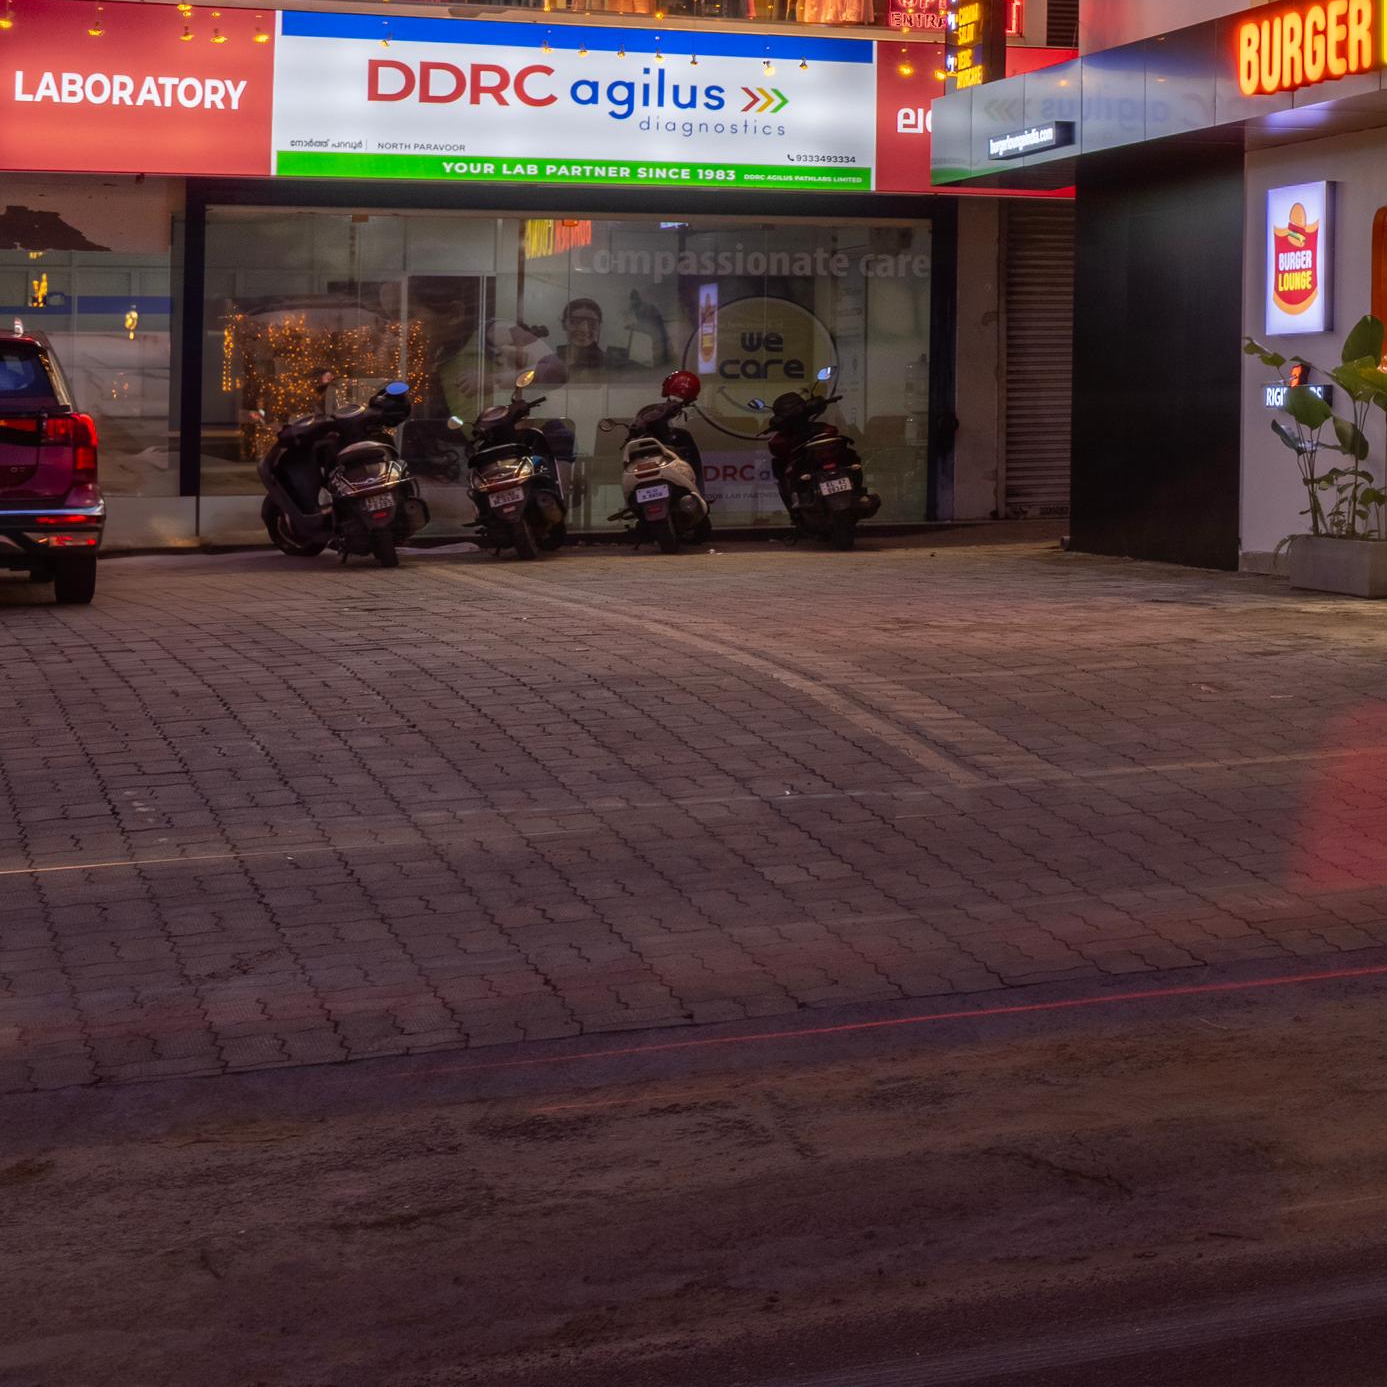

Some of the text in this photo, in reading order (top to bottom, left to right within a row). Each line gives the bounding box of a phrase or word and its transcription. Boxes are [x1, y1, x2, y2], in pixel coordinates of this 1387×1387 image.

[890, 11, 947, 29] ENTRA
[14, 70, 248, 111] LABORATORY
[367, 58, 726, 121] DDRC agilus
[639, 114, 787, 138] diagnostics
[377, 142, 467, 153] NORTH PARAVOOR
[796, 153, 856, 164] 9333493334
[442, 162, 737, 181] YOUR LAB PARTNER SINCE 1983
[743, 173, 863, 184] DDRC AGILUS PATHLABS LIMITED
[574, 242, 931, 285] Compassionate care
[1278, 249, 1313, 272] BURGER
[1278, 270, 1313, 292] LOUNGE
[741, 332, 784, 353] we
[719, 358, 805, 380] care
[702, 464, 755, 482] DRC
